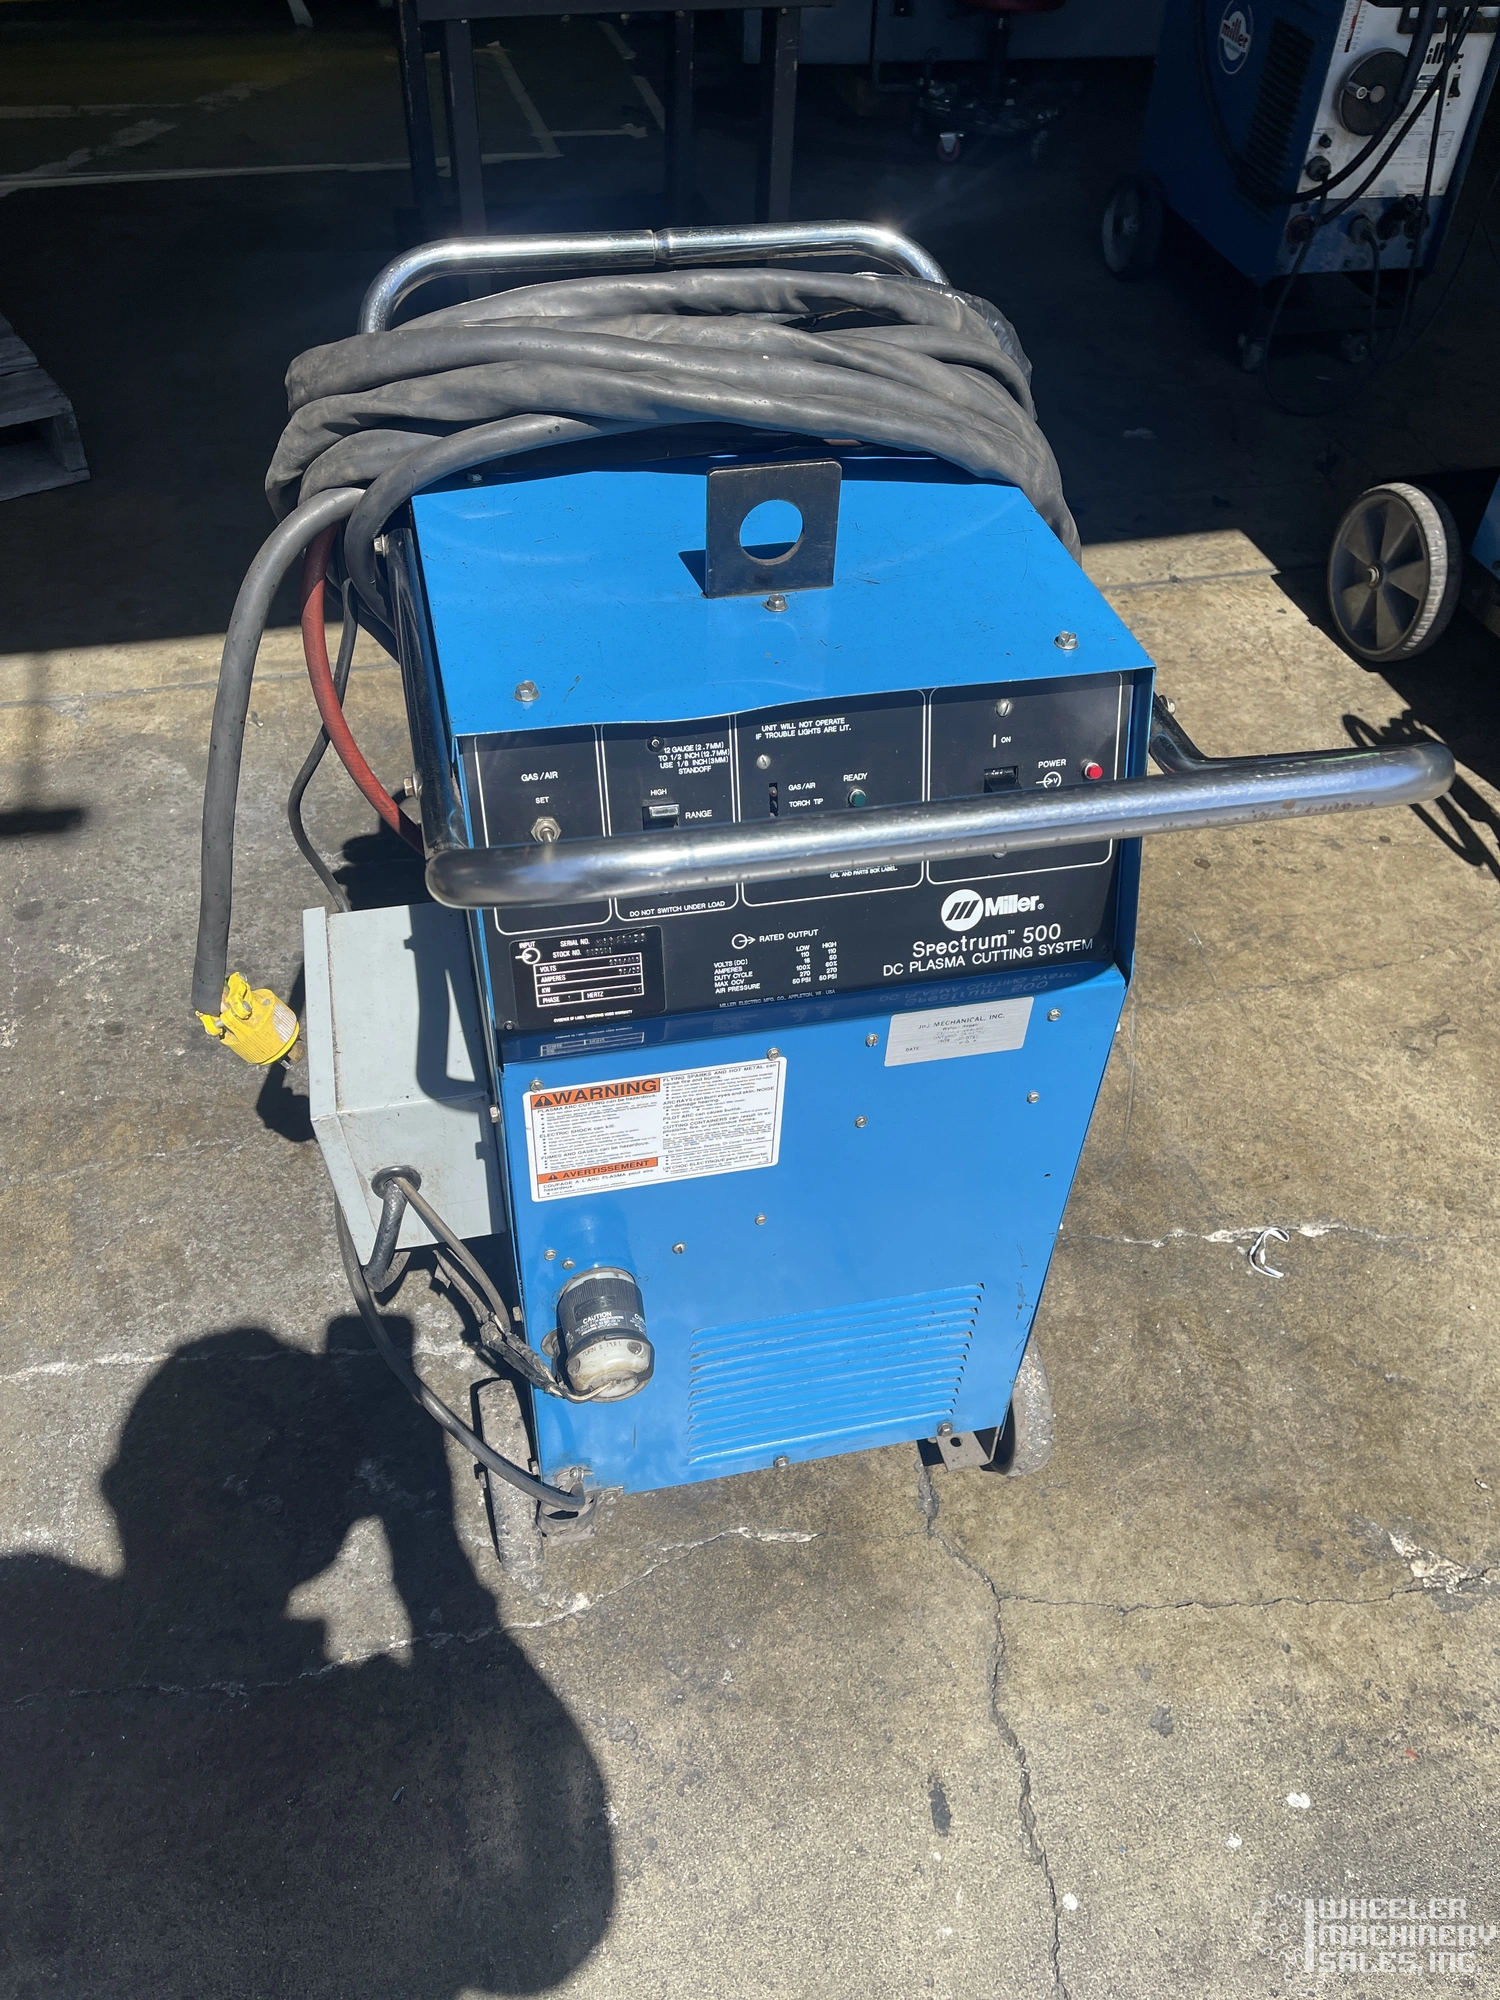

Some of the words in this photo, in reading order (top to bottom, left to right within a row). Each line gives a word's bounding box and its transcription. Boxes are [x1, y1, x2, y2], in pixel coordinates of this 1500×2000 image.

[762, 724, 777, 732] UNIT
[780, 722, 796, 730] WILL
[815, 718, 845, 726] OPERATE
[765, 731, 795, 739] TROUBLE
[798, 727, 821, 736] LIGHTS
[672, 745, 694, 753] GAUGE
[1038, 759, 1066, 768] POWER
[678, 765, 711, 775] STANDOFF
[843, 773, 867, 781] READY
[535, 796, 549, 804] SET
[685, 810, 712, 819] RANGE
[657, 906, 682, 914] SWITCH
[684, 903, 706, 911] UNDER
[759, 934, 784, 942] RATED
[787, 929, 819, 939] OUTPUT
[1023, 923, 1061, 943] 500
[552, 950, 570, 959] STOCK
[883, 964, 904, 976] DC
[910, 956, 965, 973] PLASMA
[972, 947, 1033, 965] CUTTING
[1038, 938, 1093, 956] SYSTEM
[714, 960, 733, 968] VOLTS
[714, 966, 743, 975] AMPERES
[733, 971, 753, 979] CYCLE
[541, 975, 566, 983] AMPERES
[727, 983, 761, 993] PRESSURE
[587, 991, 604, 999] HERTZ
[543, 996, 560, 1004] PHASE
[552, 1080, 657, 1104] WARNING
[562, 1160, 649, 1178] AVERTISSEMENT
[583, 1311, 612, 1324] CAUTION
